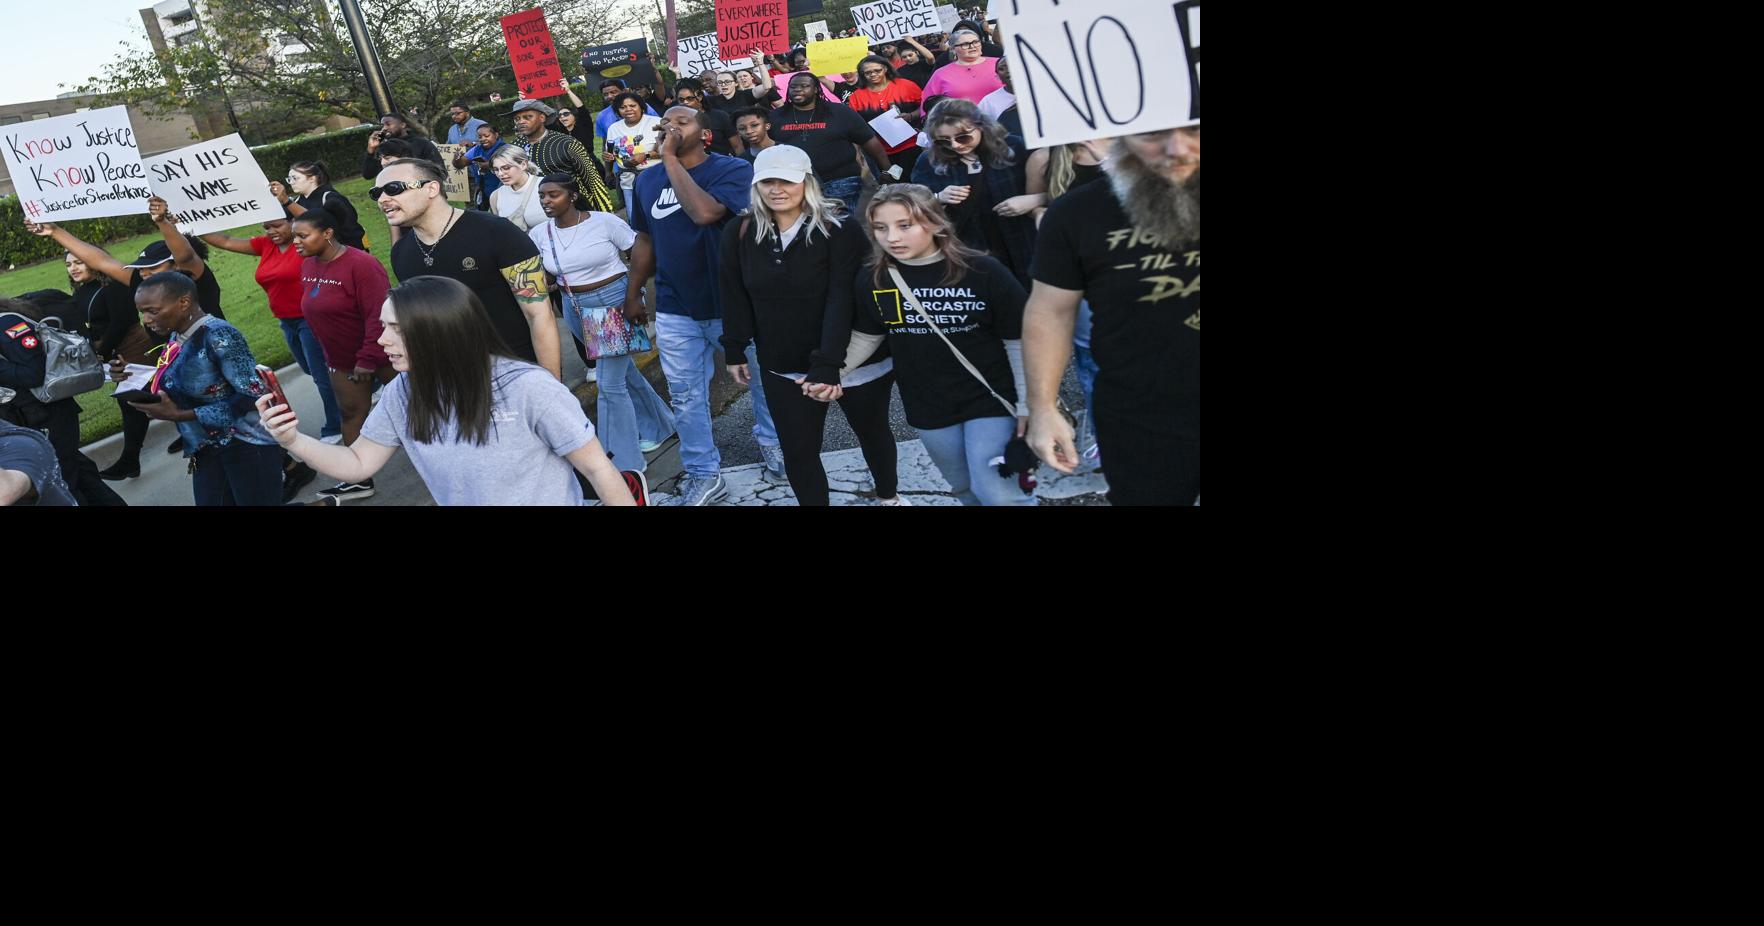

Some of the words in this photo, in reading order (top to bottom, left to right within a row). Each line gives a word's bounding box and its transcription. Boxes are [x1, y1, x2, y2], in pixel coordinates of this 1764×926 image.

[718, 2, 783, 21] EVERYWHERE
[852, 6, 874, 25] NO
[506, 19, 547, 40] PROTECT
[720, 19, 782, 42] JUSTICE
[861, 23, 885, 41] NO
[885, 11, 936, 38] PEACE
[520, 36, 542, 48] OUR
[679, 34, 718, 53] JUST
[721, 40, 778, 58] NOWHERE
[1014, 15, 1144, 138] NO
[6, 133, 72, 163] Know
[76, 121, 136, 148] Justice
[30, 163, 95, 191] Know
[96, 151, 146, 183] Peace
[151, 158, 190, 182] SAY
[195, 147, 239, 171] HIS
[181, 177, 238, 201] NAME
[658, 187, 679, 205] NI
[905, 288, 976, 298] ATIONAL
[903, 301, 986, 311] SRCASTIC
